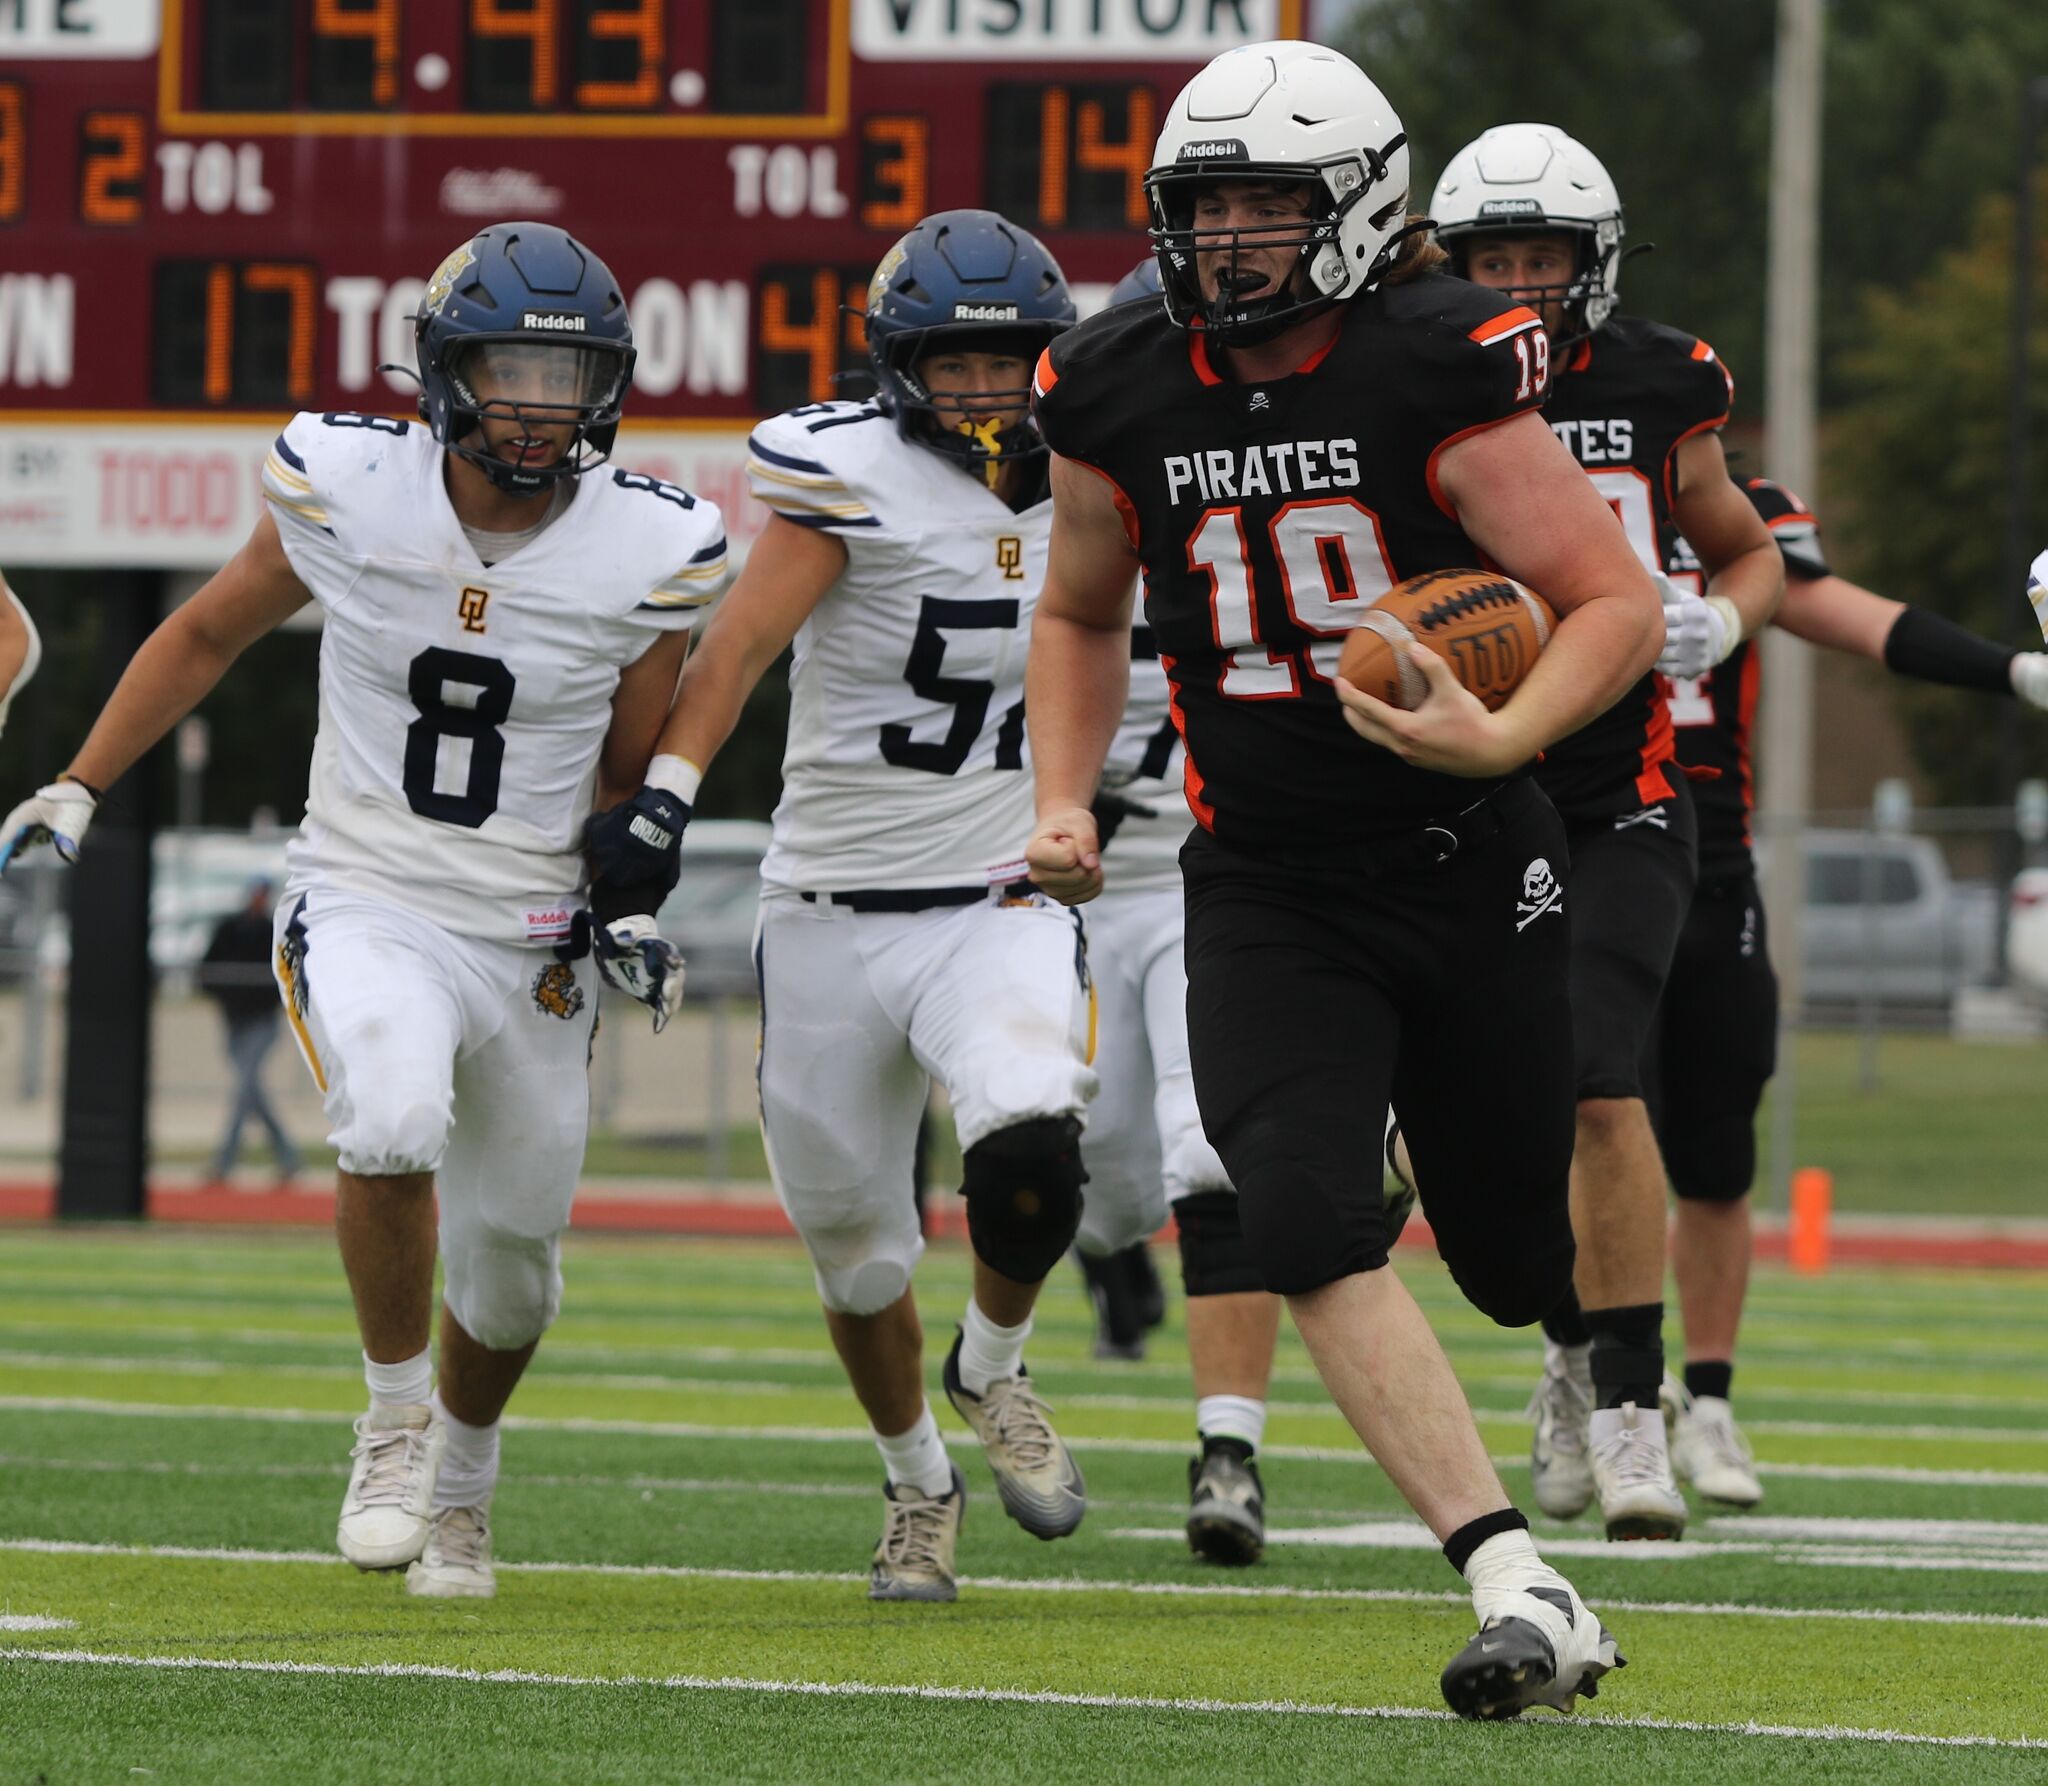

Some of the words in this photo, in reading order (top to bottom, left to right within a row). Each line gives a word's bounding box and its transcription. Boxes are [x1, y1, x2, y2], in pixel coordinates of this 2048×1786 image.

[82, 112, 144, 225] 2
[155, 140, 274, 215] TOL
[728, 146, 848, 218] TOL
[861, 116, 929, 229] 3
[1039, 86, 1154, 229] 14
[1183, 141, 1237, 158] Riddell
[1483, 200, 1536, 214] Riddell
[205, 265, 315, 403] 17
[523, 313, 586, 331] Riddell
[760, 267, 868, 403] 4
[953, 304, 1018, 321] Riddell
[1514, 329, 1549, 402] 19
[1163, 438, 1361, 506] PIRATES
[1552, 418, 1633, 462] TES
[612, 468, 696, 510] 8
[402, 645, 516, 829] 8
[527, 910, 570, 925] Riddell
